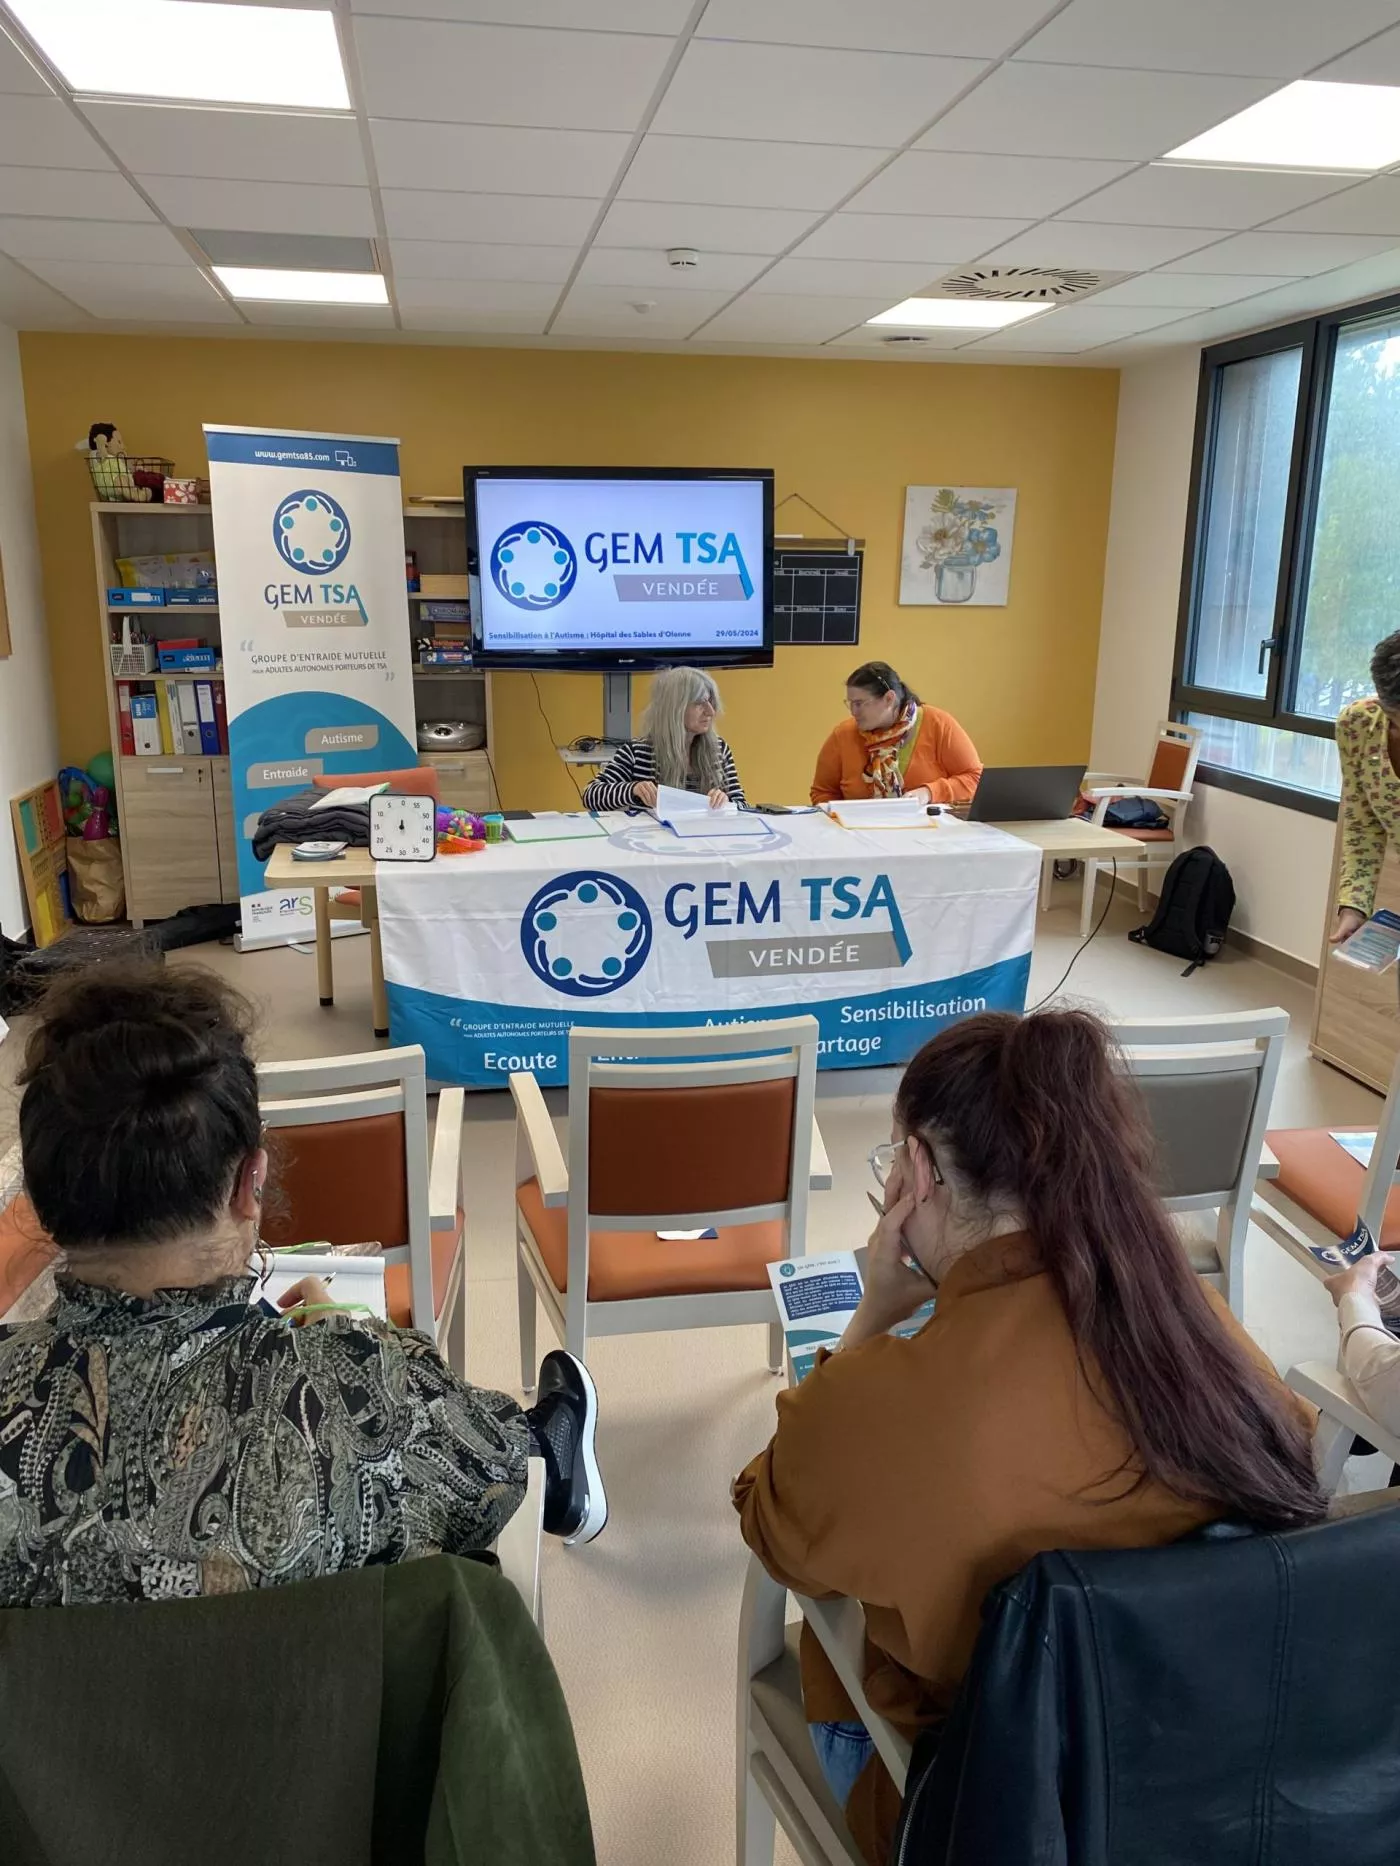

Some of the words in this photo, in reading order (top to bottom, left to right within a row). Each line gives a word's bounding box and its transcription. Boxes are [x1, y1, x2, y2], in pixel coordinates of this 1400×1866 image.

[255, 450, 330, 461] www.gemtsa85.com
[584, 532, 663, 573] GEM
[643, 578, 718, 595] VENDÉE
[264, 584, 313, 609] GEM
[301, 612, 347, 624] VENDÉE
[251, 653, 287, 664] GROUPE
[290, 652, 341, 661] D'ENTRAIDE
[344, 651, 386, 660] MUTUELLE
[265, 665, 293, 674] ADULTES
[294, 664, 334, 672] AUTONOMES
[335, 663, 366, 671] PORTEURS
[321, 733, 363, 744] Autisme
[263, 767, 308, 780] Entraide
[279, 896, 313, 916] ars
[664, 880, 780, 940] GEM
[749, 940, 860, 968] VENDÉE
[840, 996, 986, 1024] Sensibilisation
[462, 1023, 492, 1032] GROUPE
[493, 1022, 537, 1030] D'ENTRAIDE
[816, 1036, 881, 1056] artage
[484, 1051, 557, 1071] Ecoute
